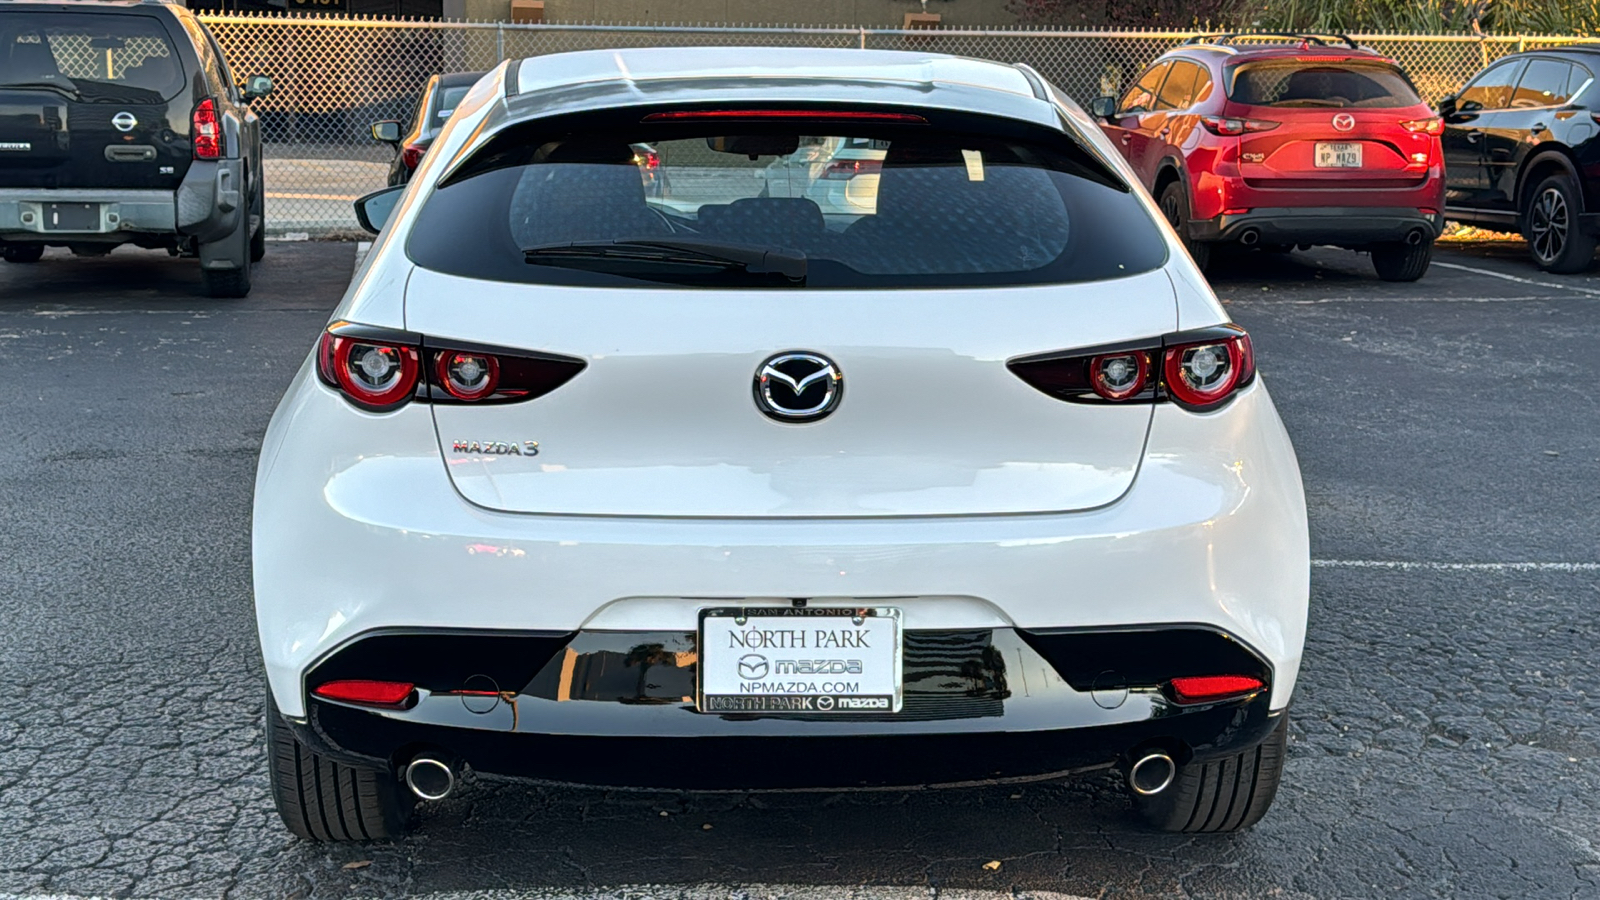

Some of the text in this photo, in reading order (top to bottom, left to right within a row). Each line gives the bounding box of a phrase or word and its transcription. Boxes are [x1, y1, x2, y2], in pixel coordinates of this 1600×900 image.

[1321, 152, 1331, 163] NP
[747, 608, 853, 616] SAN ANTONIO
[728, 626, 871, 651] NORTH PARK
[775, 659, 863, 675] mazda
[739, 682, 860, 693] NPMAZDA.COM
[709, 696, 889, 710] NORTH PARK mazda
